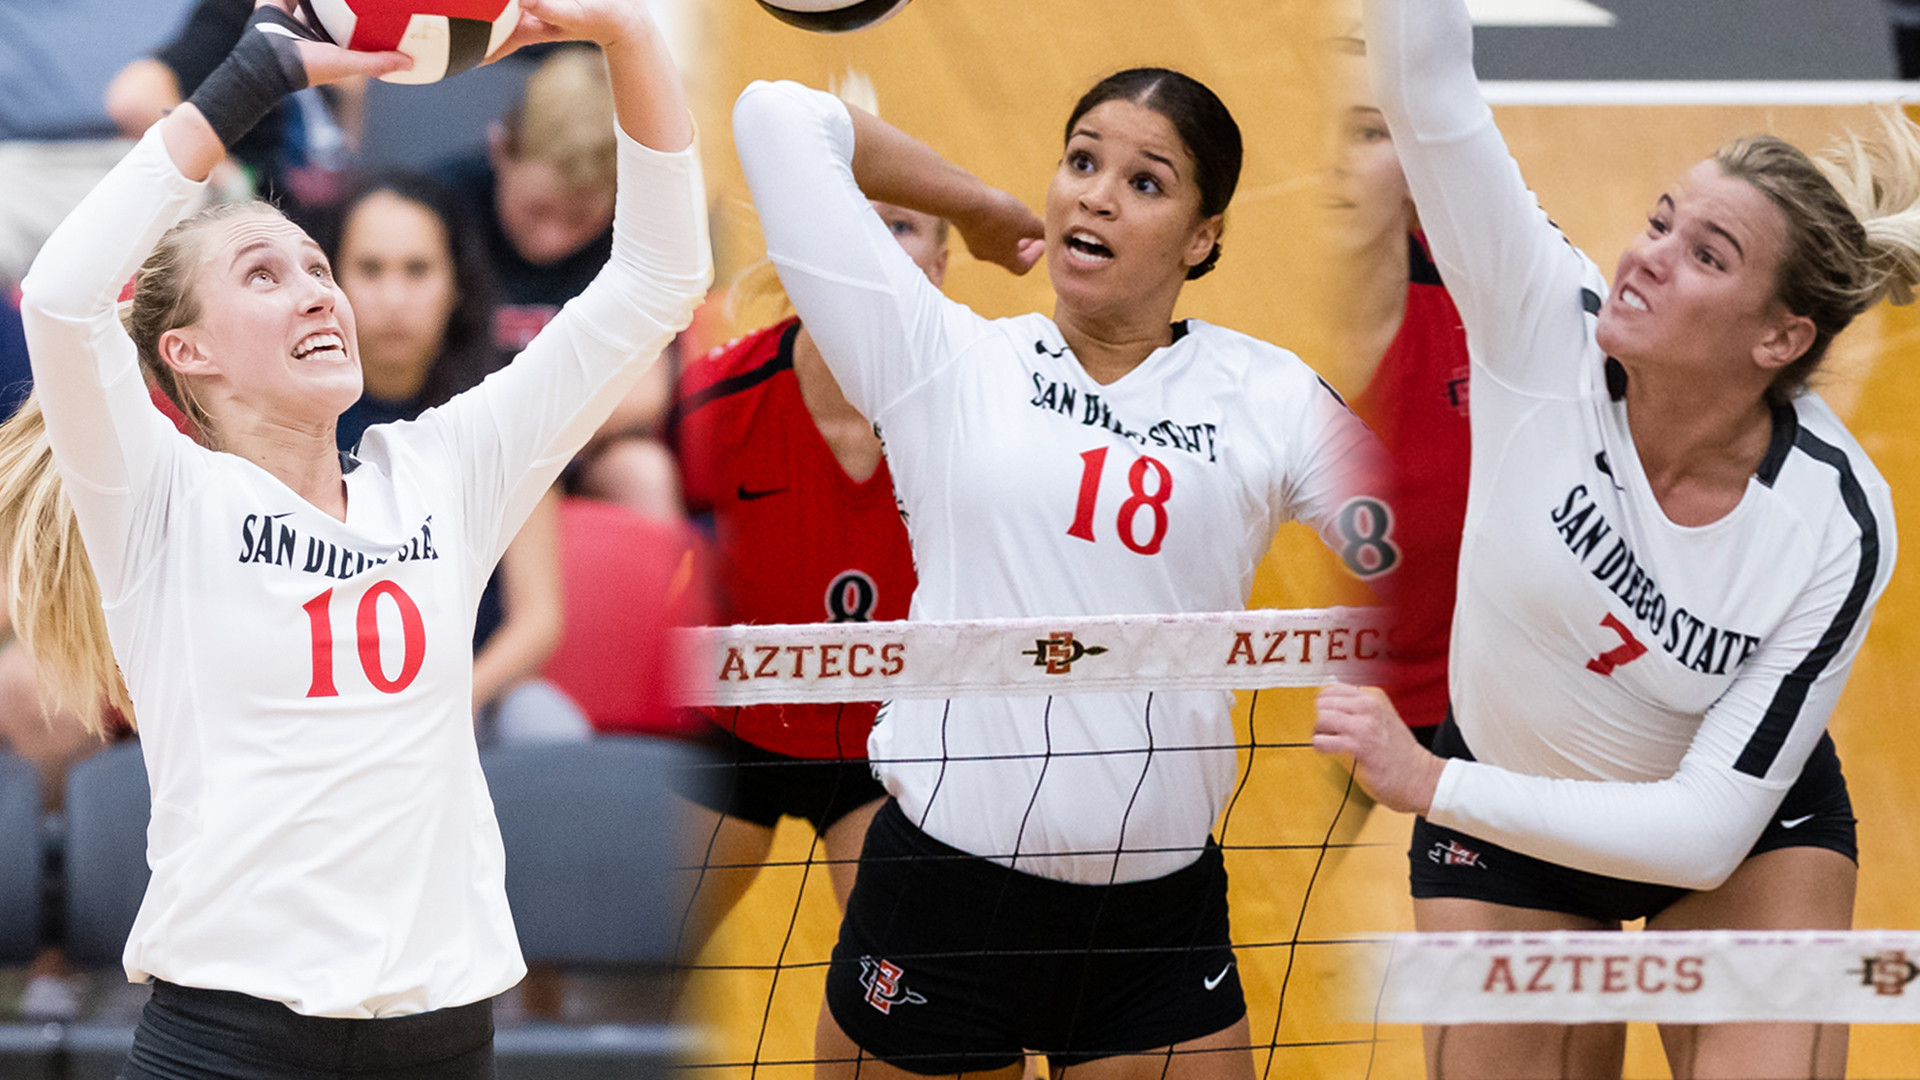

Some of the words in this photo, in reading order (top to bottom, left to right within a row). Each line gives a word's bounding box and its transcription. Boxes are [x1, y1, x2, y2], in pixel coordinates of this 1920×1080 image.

[1031, 371, 1077, 418] SAN
[1066, 446, 1173, 556] 18
[238, 513, 296, 570] SAN
[1335, 495, 1402, 581] 8
[1550, 484, 1612, 563] SAN
[1591, 536, 1667, 636] DIEGO
[1662, 607, 1761, 675] STATE
[302, 579, 426, 698] 10
[718, 643, 906, 681] AZTECS
[1585, 611, 1649, 676] 7
[1481, 955, 1705, 993] AZTECS
